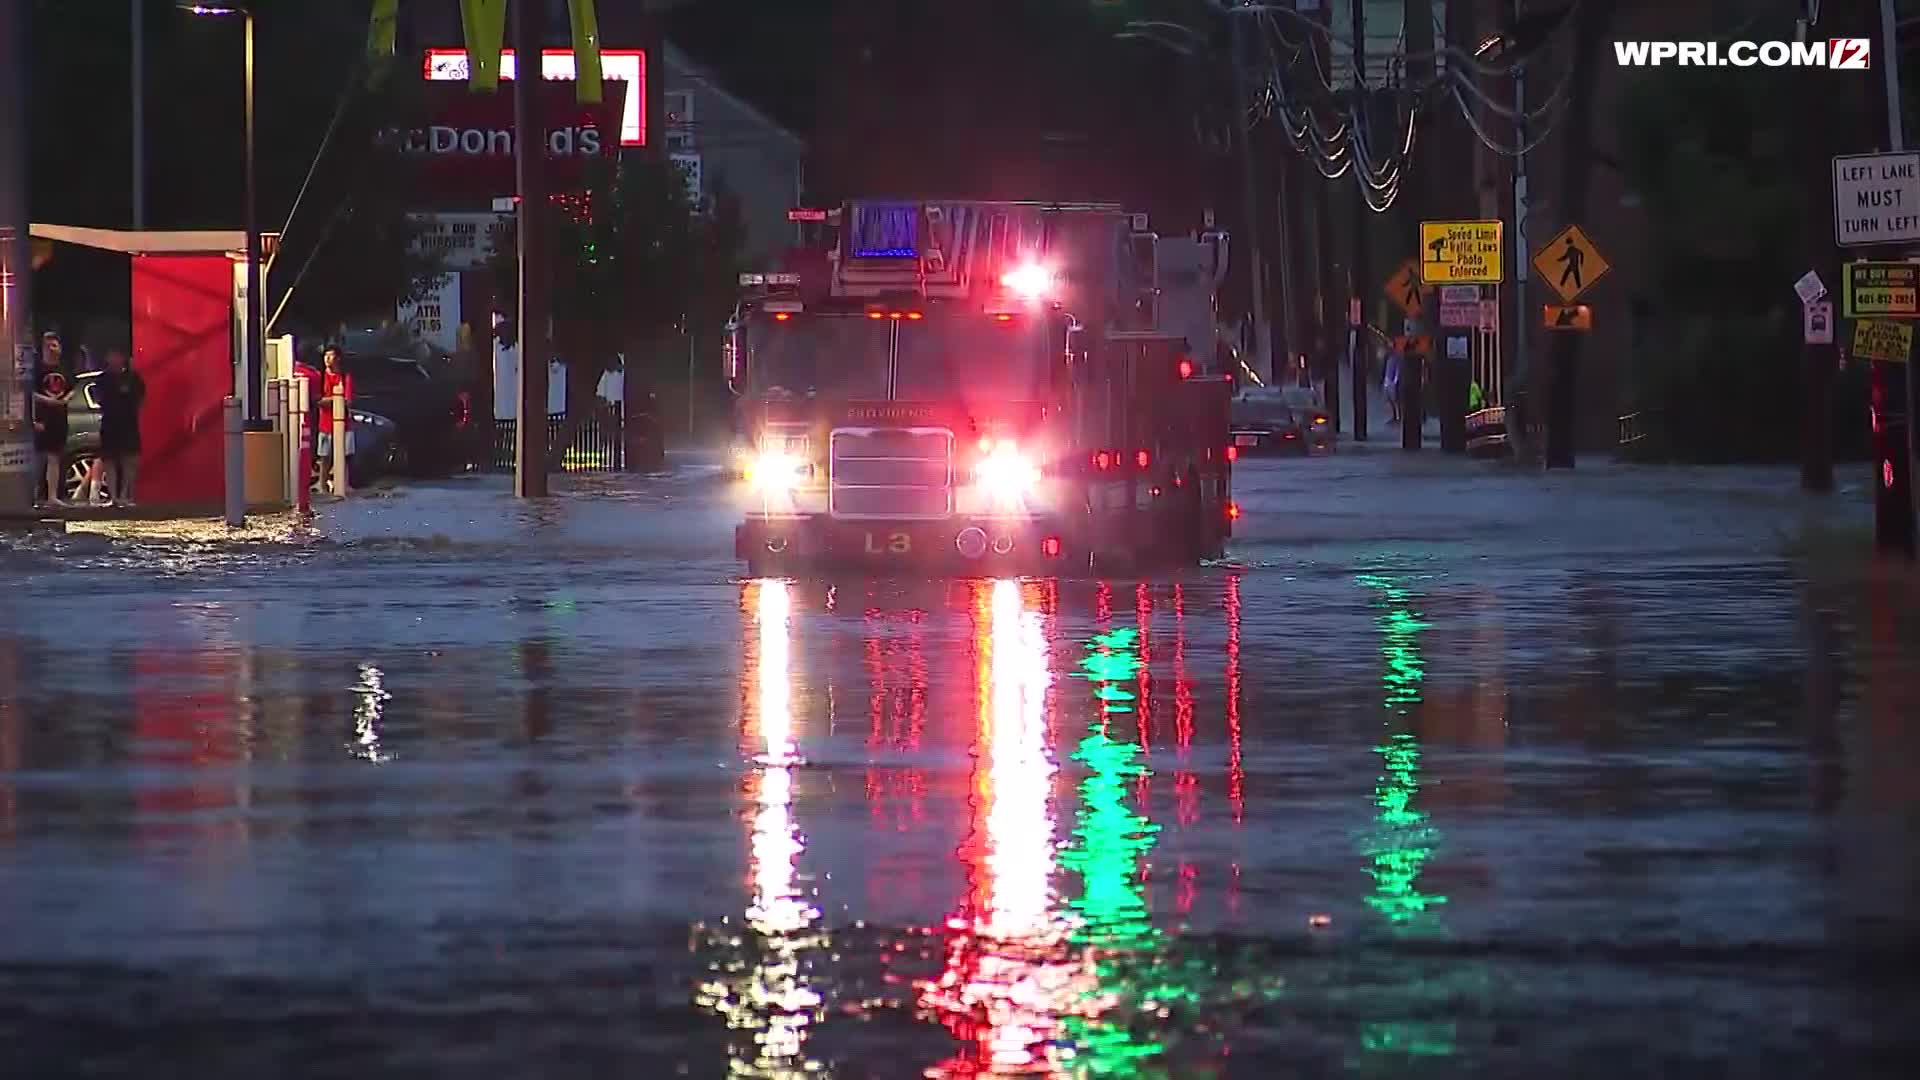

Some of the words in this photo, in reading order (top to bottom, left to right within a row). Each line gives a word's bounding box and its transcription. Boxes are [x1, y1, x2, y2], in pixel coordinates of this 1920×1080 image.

[1843, 167, 1872, 181] LEFT
[1882, 164, 1915, 180] LANE
[1857, 189, 1902, 208] MUST
[1845, 217, 1878, 233] TURN
[1887, 215, 1919, 231] LEFT
[1448, 228, 1472, 240] Speed
[1476, 227, 1497, 239] Limit
[1478, 241, 1497, 252] Laws
[1457, 254, 1483, 265] Photo
[1449, 265, 1487, 277] Enforced
[416, 305, 441, 318] ATM
[865, 532, 912, 553] L3
